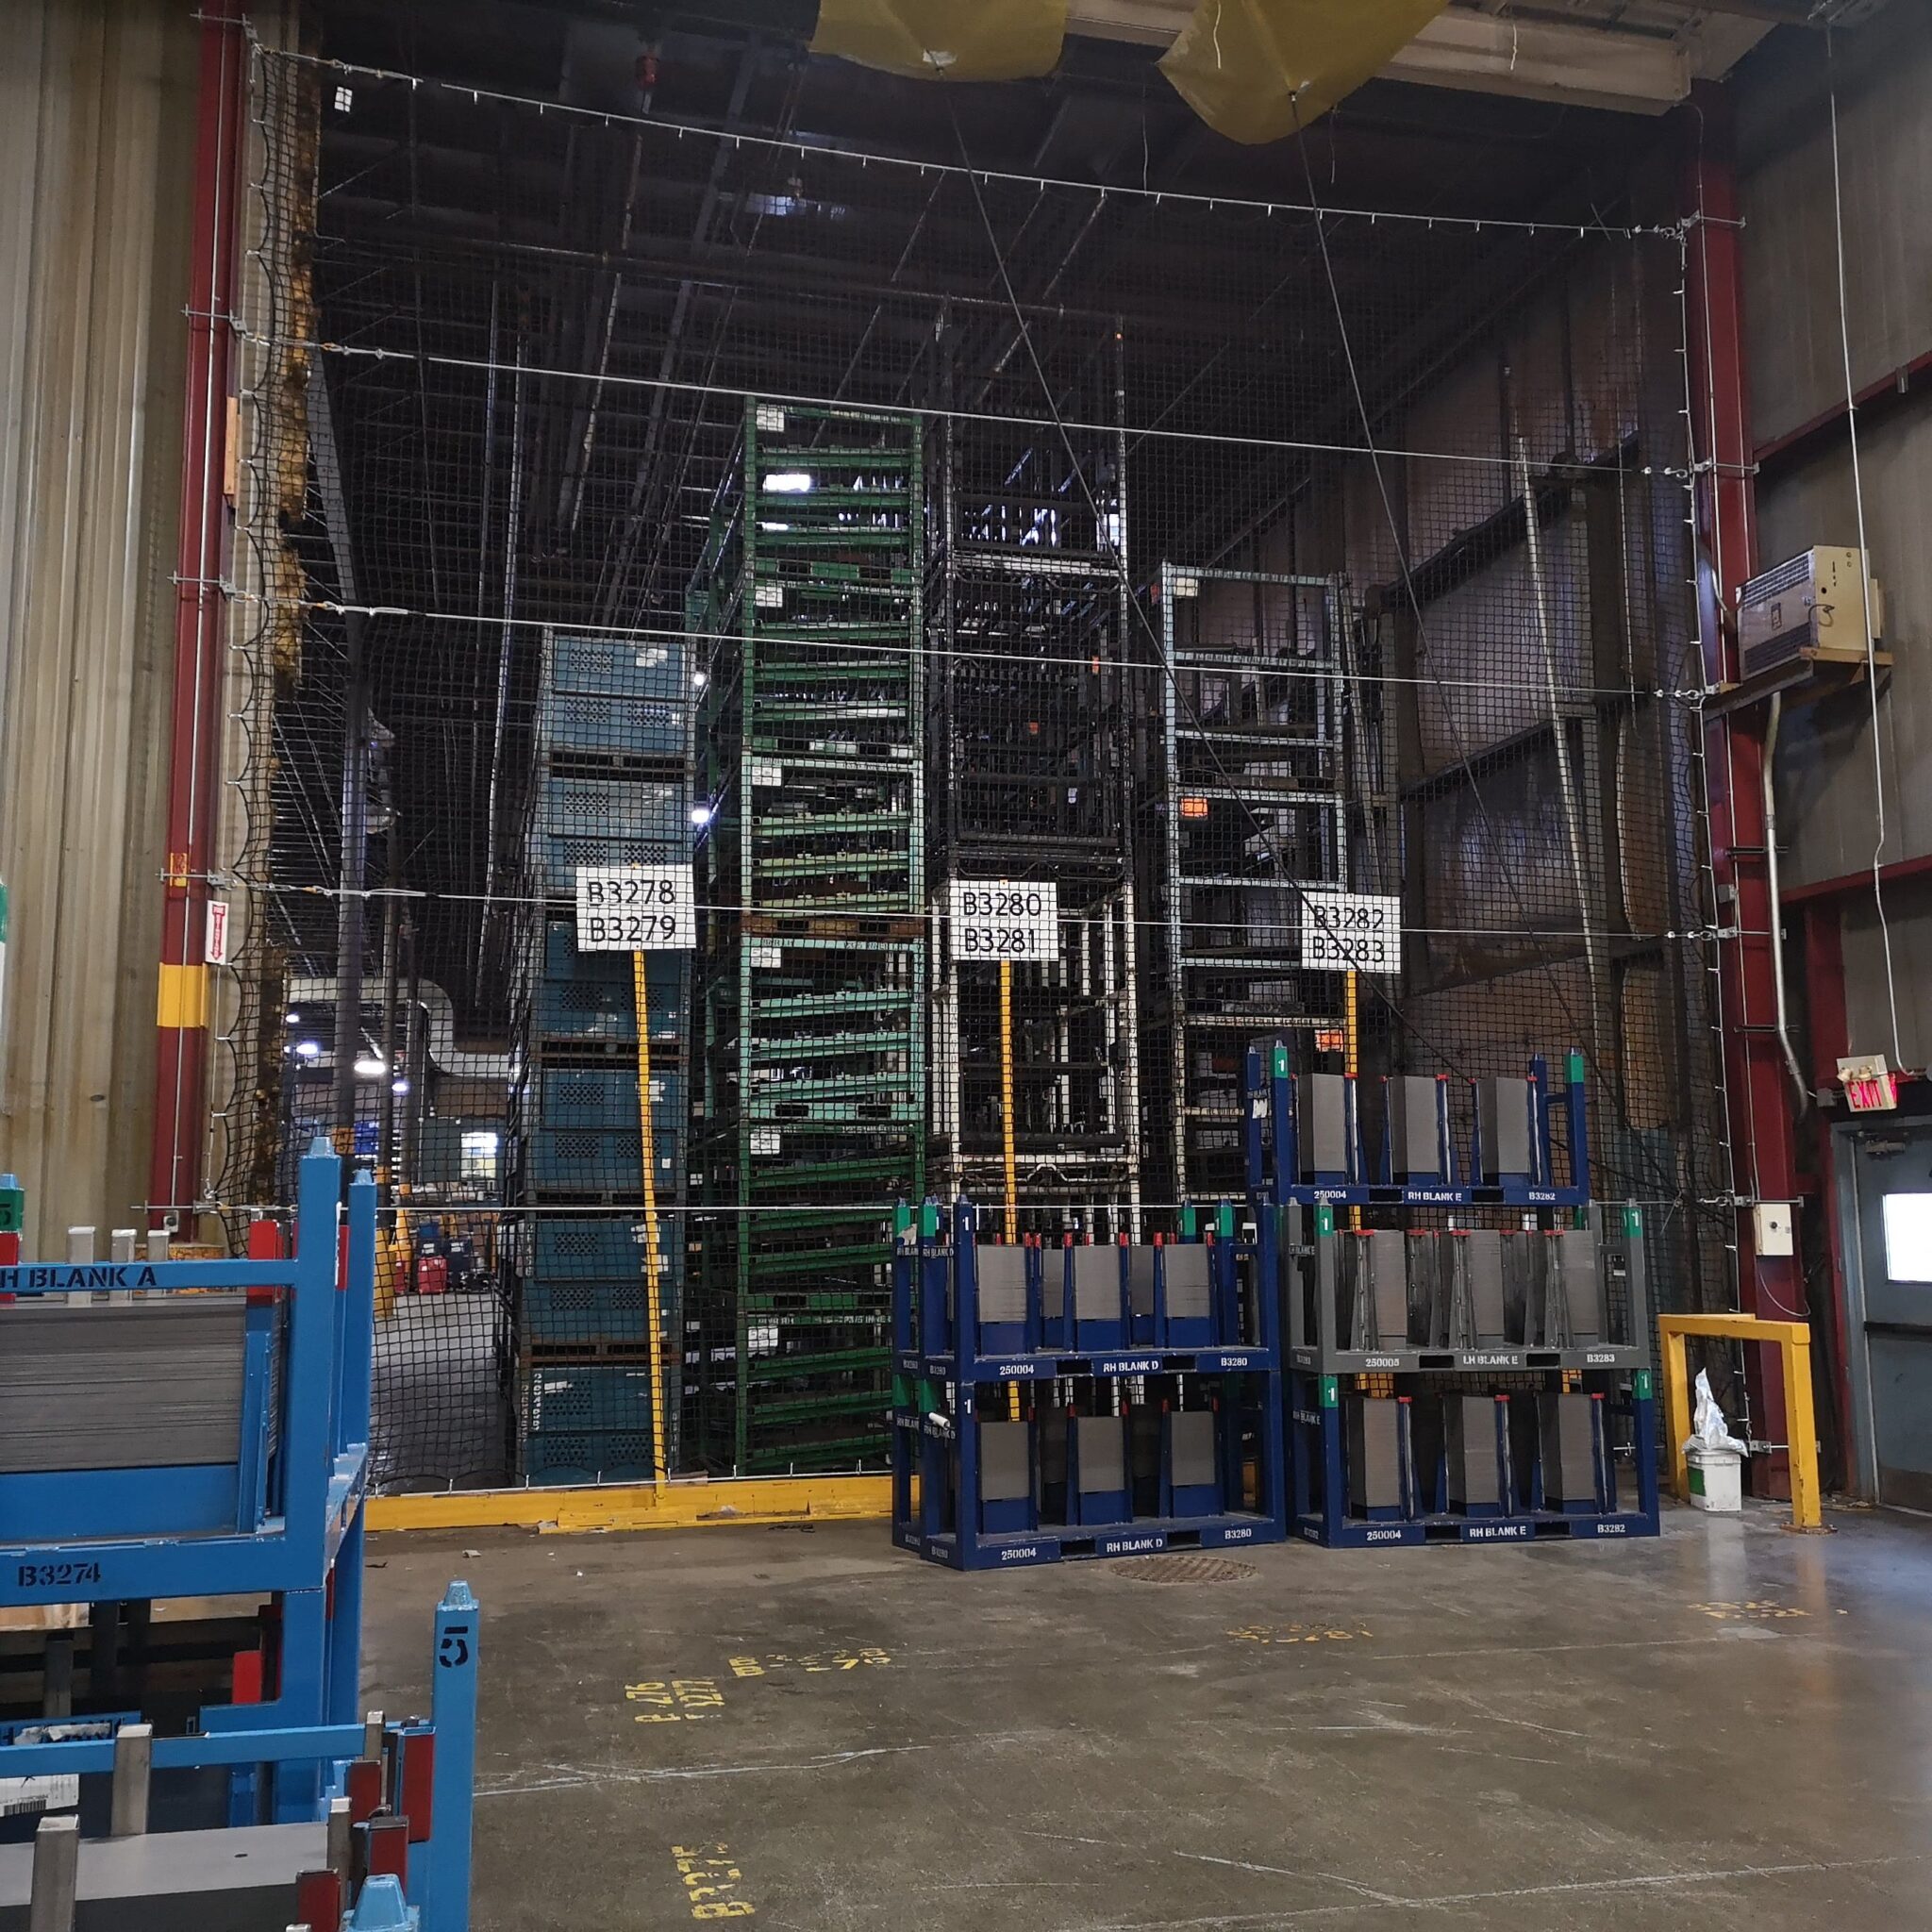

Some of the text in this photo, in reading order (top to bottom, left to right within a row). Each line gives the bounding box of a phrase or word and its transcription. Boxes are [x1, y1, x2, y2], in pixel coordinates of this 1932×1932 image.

[588, 879, 675, 907] B3278
[963, 891, 1041, 917] B3280
[1313, 905, 1384, 929] B3282
[590, 915, 676, 942] B3279
[965, 928, 1035, 954] B3281
[1312, 936, 1385, 962] B3283
[1278, 1058, 1285, 1073] 1
[1847, 1079, 1882, 1109] EXIT
[1313, 1190, 1556, 1201] 250004 RH BLANK E B3282
[962, 1216, 970, 1231] 1
[1321, 1217, 1328, 1231] 1
[1632, 1211, 1639, 1226] 1
[0, 1265, 158, 1289] H BLANK A
[999, 1357, 1248, 1375] 250004 RH BLANK D B3280
[1462, 1356, 1476, 1365] LH
[1477, 1356, 1509, 1365] BLANK
[1511, 1356, 1518, 1364] E
[1587, 1354, 1615, 1363] B3283
[1641, 1374, 1648, 1390] 1
[1327, 1387, 1335, 1402] 1
[964, 1398, 972, 1414] 1
[1366, 1524, 1625, 1541] 250004 RH BLANK E B3282
[1001, 1528, 1252, 1560] 250004 RH BLANK D B3280
[18, 1562, 101, 1587] B3274
[439, 1625, 469, 1668] 5
